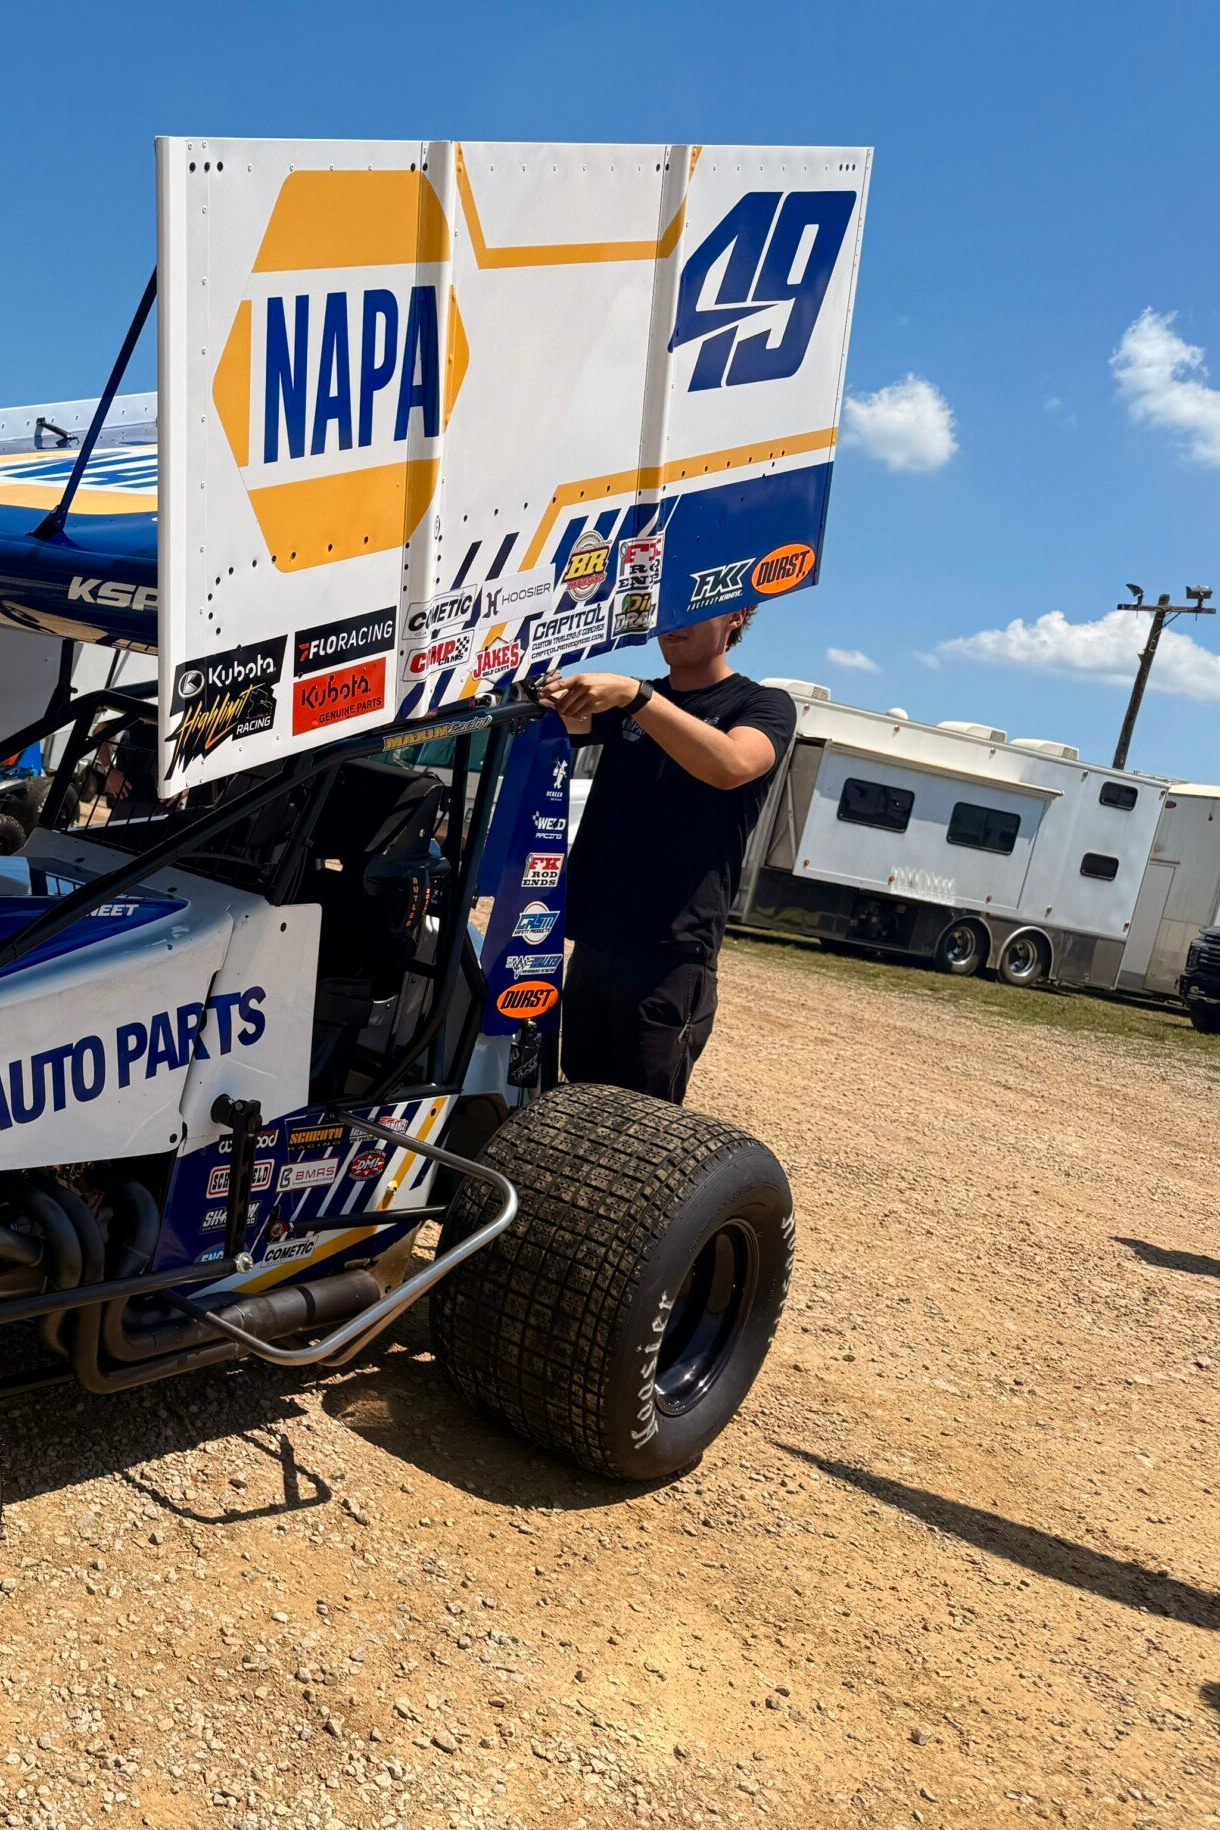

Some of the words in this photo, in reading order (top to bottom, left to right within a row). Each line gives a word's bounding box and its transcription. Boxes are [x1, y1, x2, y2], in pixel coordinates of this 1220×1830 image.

[668, 190, 857, 392] 49
[264, 284, 441, 464] NAPA
[501, 582, 551, 606] HOOSIER
[532, 602, 606, 642] CAPITOL
[307, 620, 394, 660] FLORACING
[208, 653, 277, 688] Kubota
[437, 652, 464, 666] CAMS
[472, 640, 521, 679] JAKE'S
[301, 672, 372, 710] Kubota
[318, 706, 356, 724] GENUINE
[356, 697, 383, 716] PARTS
[236, 715, 272, 736] RACING
[537, 817, 567, 831] WELD
[528, 857, 562, 870] FK
[500, 988, 556, 1010] DURST
[116, 985, 267, 1089] PARTS
[289, 1127, 344, 1145] SCHROTH
[295, 1166, 335, 1181] BMRS
[356, 1157, 381, 1170] DMI
[264, 1241, 315, 1262] COMETIC
